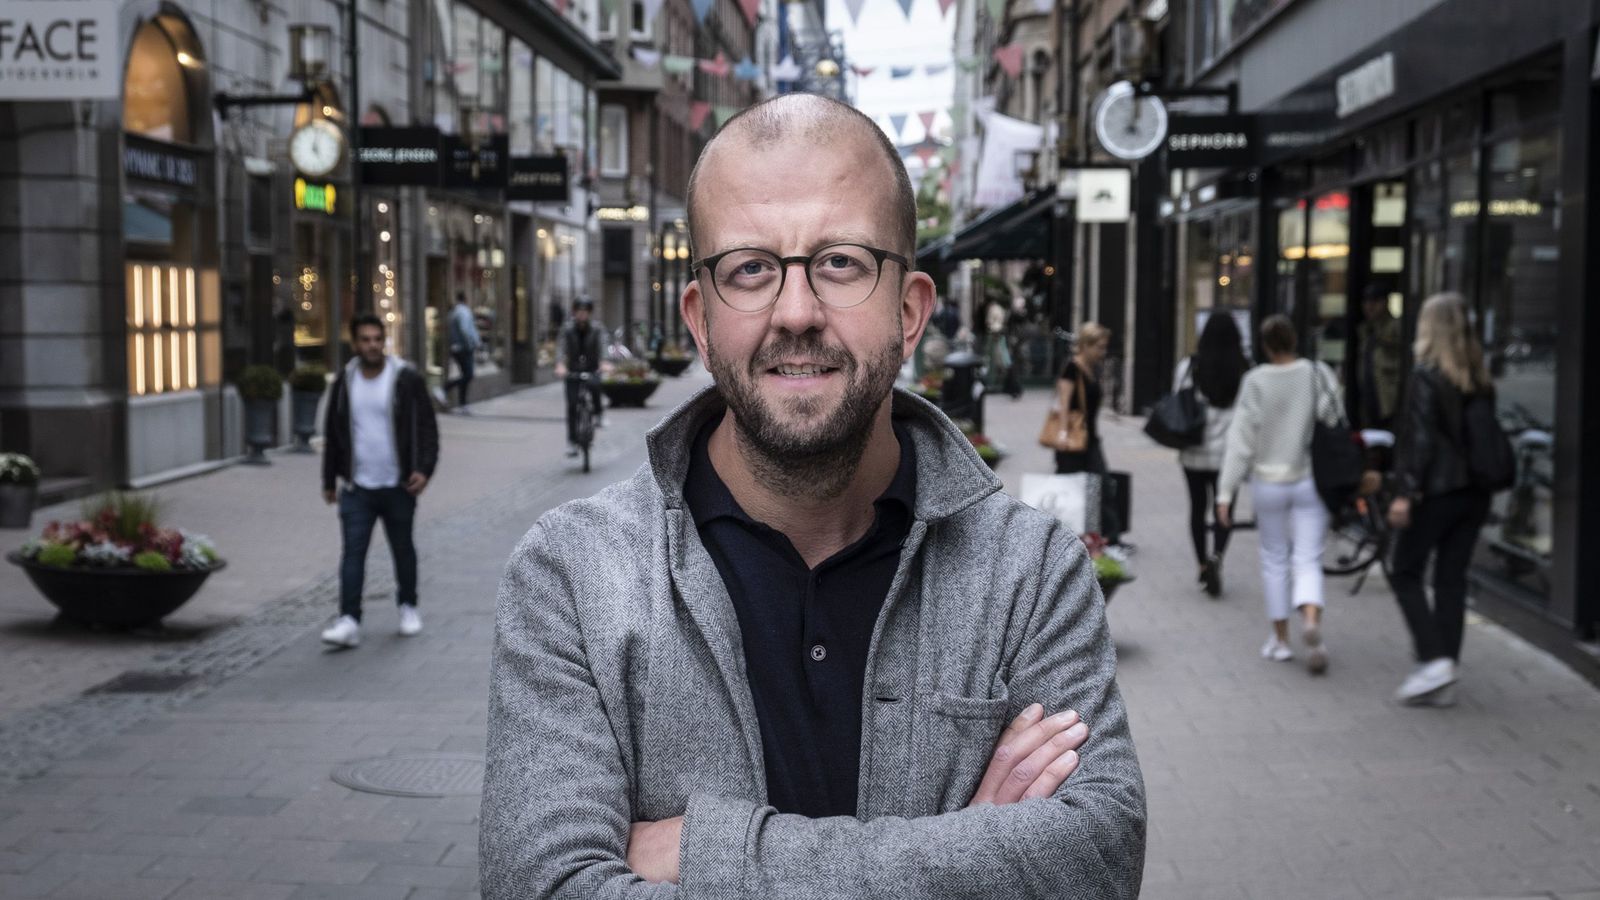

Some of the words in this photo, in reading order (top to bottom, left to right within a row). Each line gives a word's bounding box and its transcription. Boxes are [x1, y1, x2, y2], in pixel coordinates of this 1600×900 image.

[0, 19, 97, 61] FACE
[1169, 133, 1247, 150] SEPHORA
[395, 147, 438, 164] JENSEN
